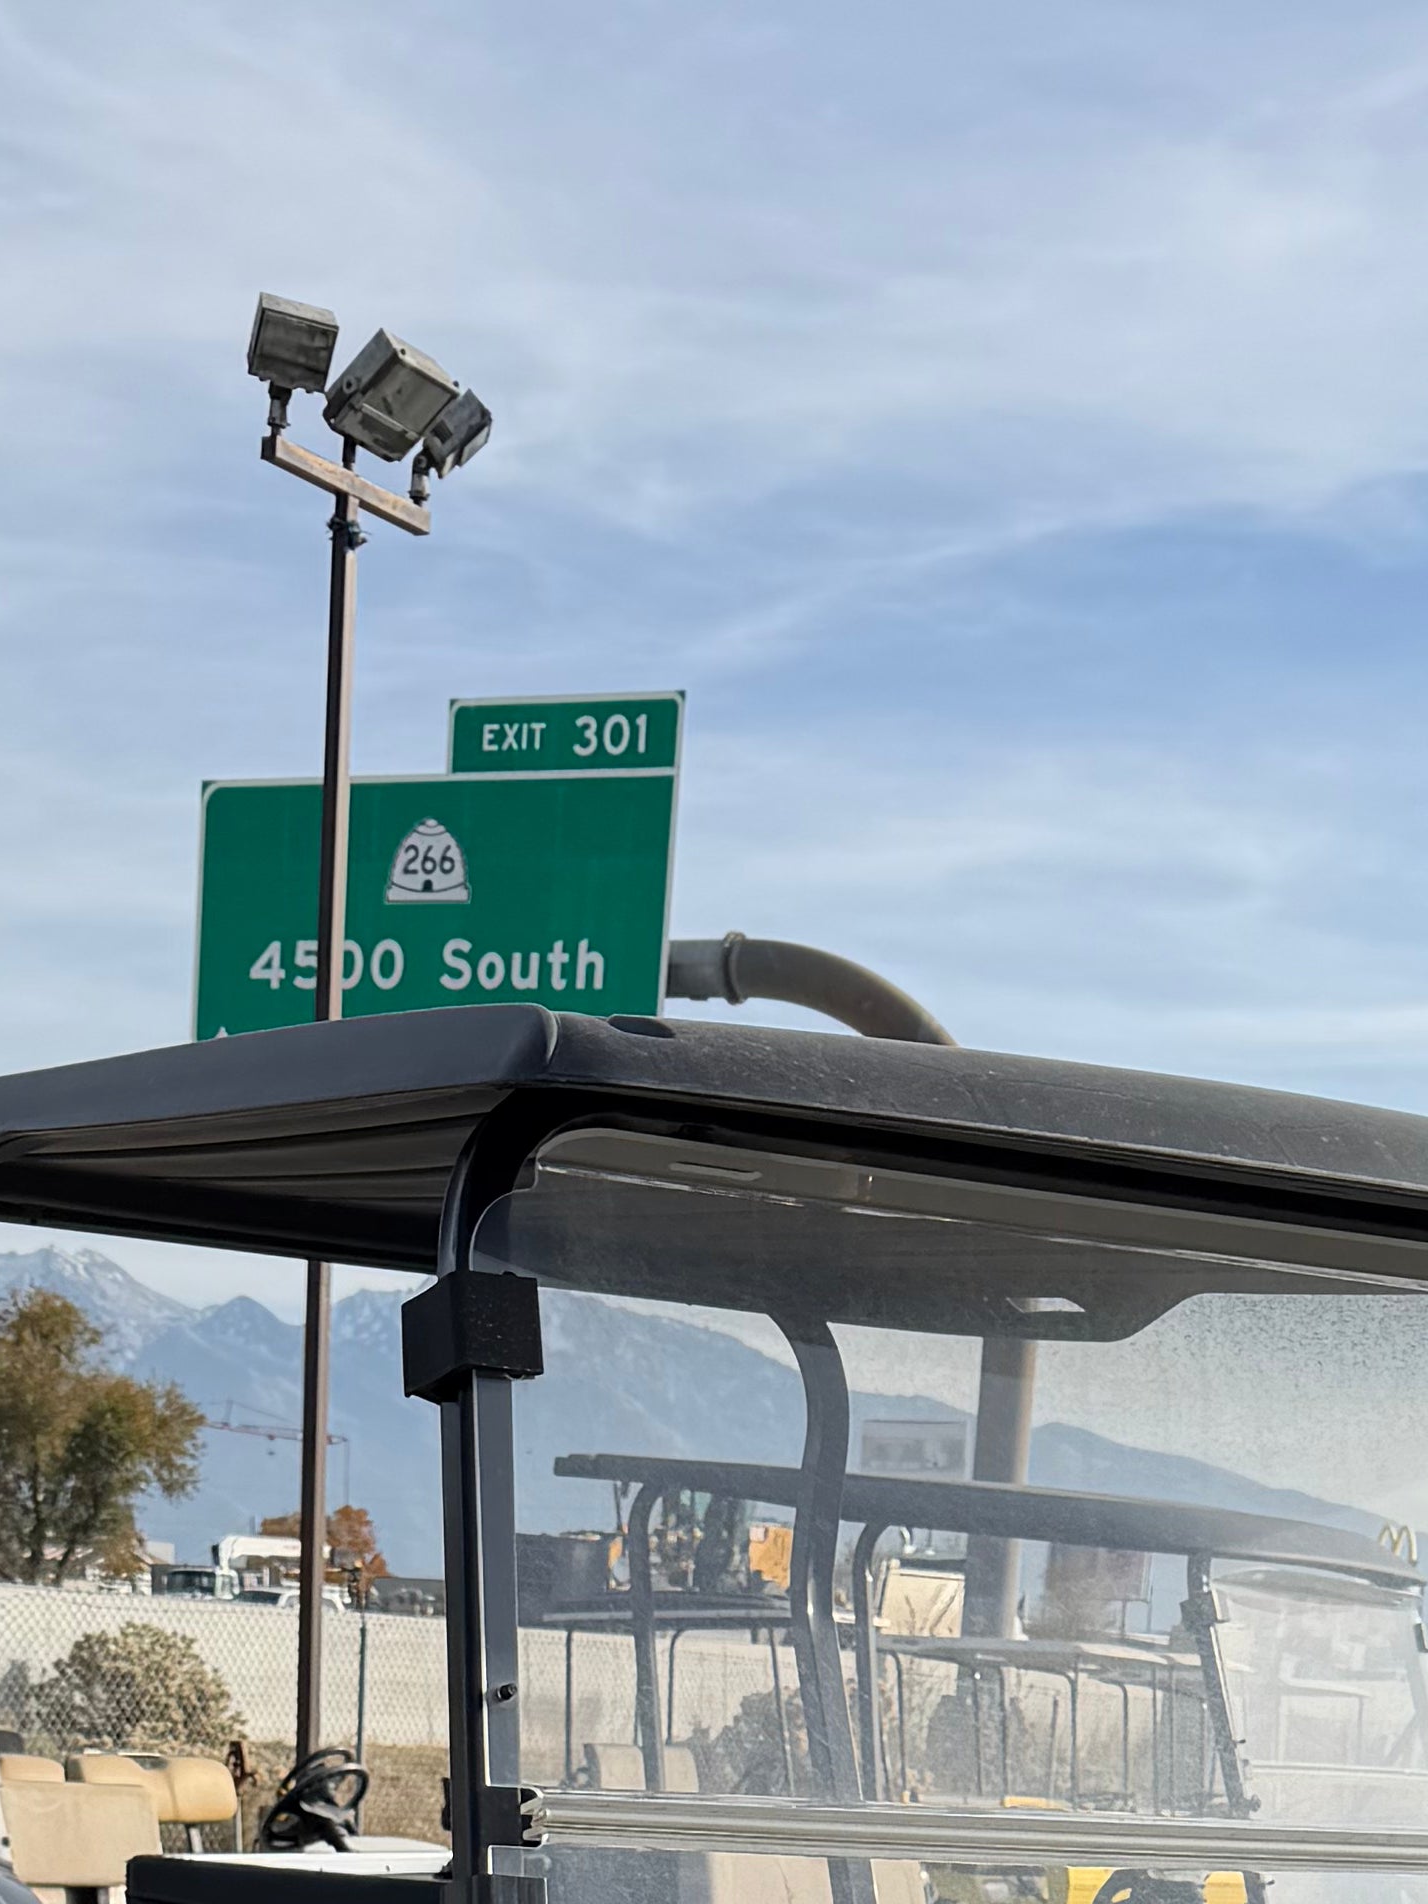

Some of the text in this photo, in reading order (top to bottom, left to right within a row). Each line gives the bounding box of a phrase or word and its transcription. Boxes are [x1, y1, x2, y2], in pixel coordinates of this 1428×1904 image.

[482, 713, 648, 756] EXIT 301
[402, 844, 455, 875] 266
[249, 938, 605, 991] 4500 South
